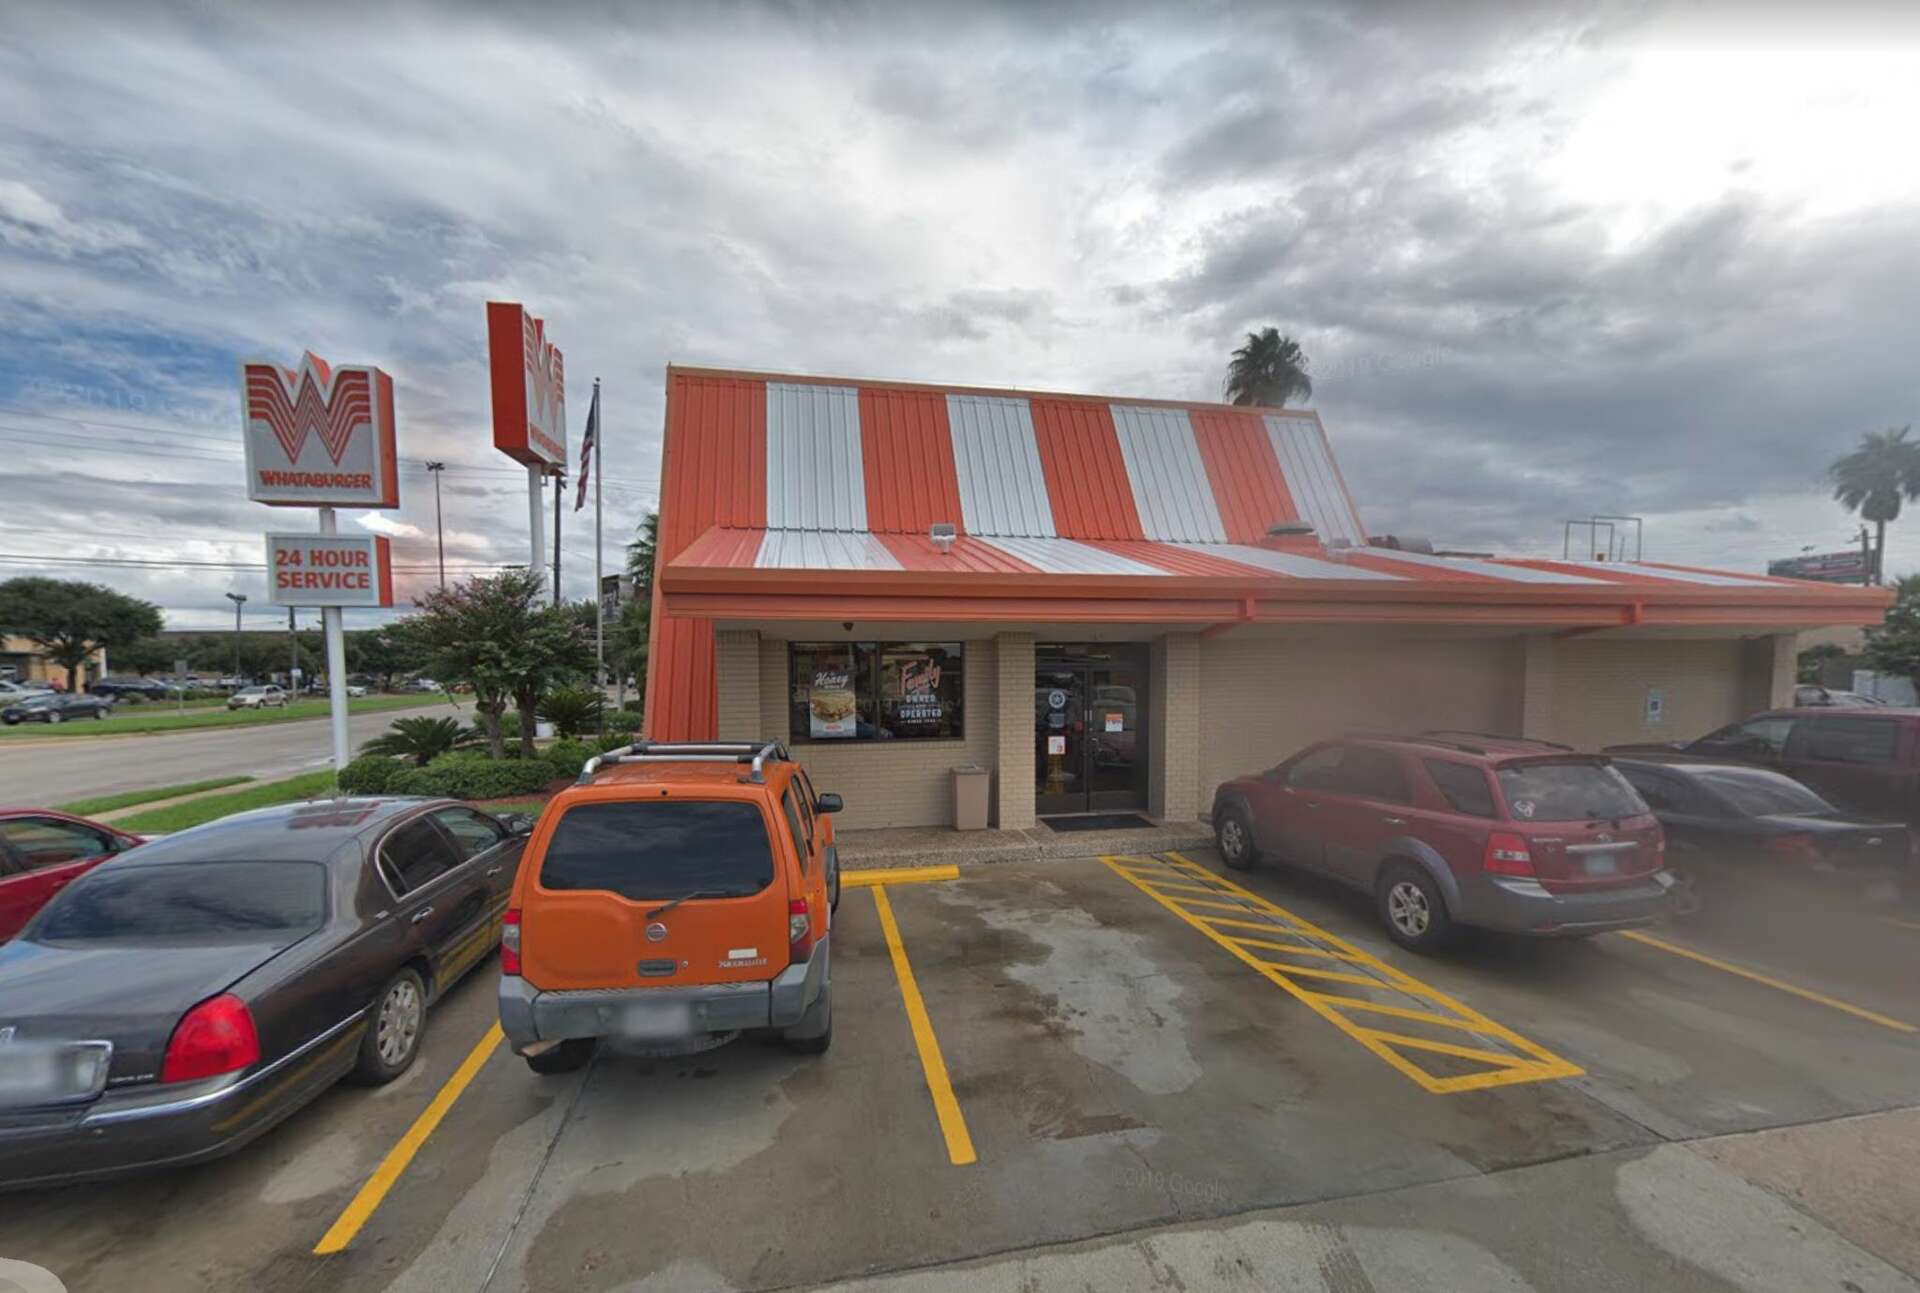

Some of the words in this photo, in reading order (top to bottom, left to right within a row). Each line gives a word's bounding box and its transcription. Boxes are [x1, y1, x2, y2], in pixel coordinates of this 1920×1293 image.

[259, 470, 372, 489] WHATABURGER
[276, 549, 303, 567] 24
[309, 549, 369, 567] HOUR
[276, 571, 369, 590] SERVICE
[900, 709, 942, 719] OPERATED
